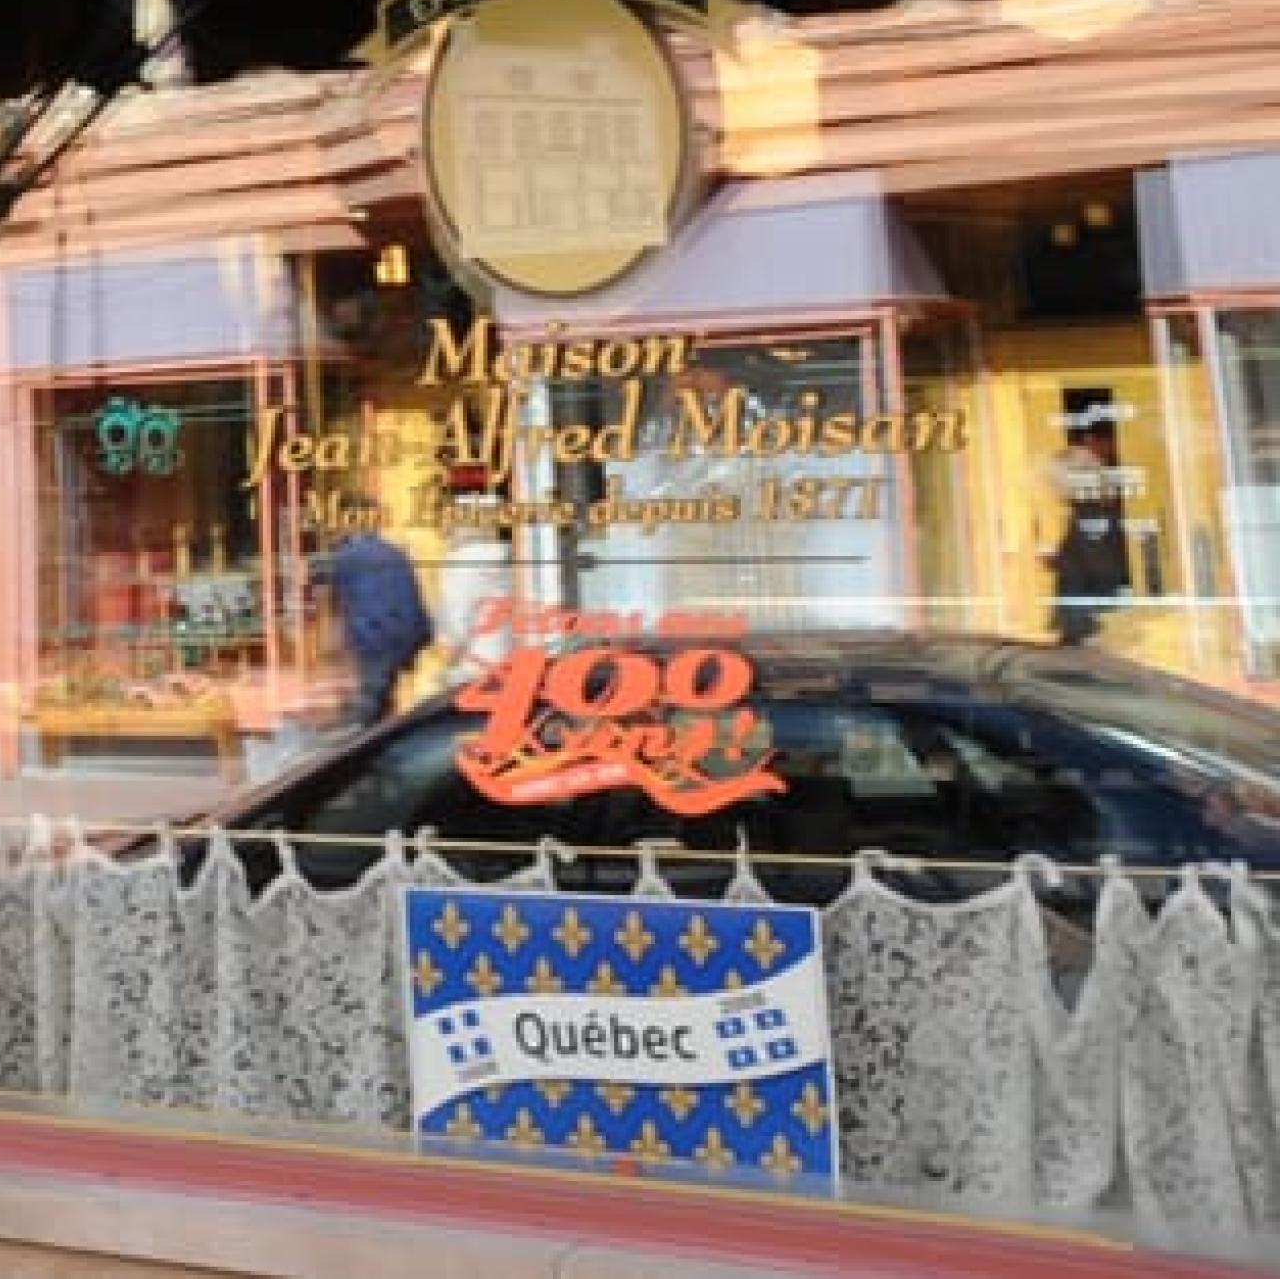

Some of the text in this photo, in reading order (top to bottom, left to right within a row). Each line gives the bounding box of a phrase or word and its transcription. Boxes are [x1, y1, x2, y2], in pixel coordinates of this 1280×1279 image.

[417, 317, 689, 387] Maison
[669, 386, 970, 461] Moisan
[513, 1011, 700, 1065] Québec
